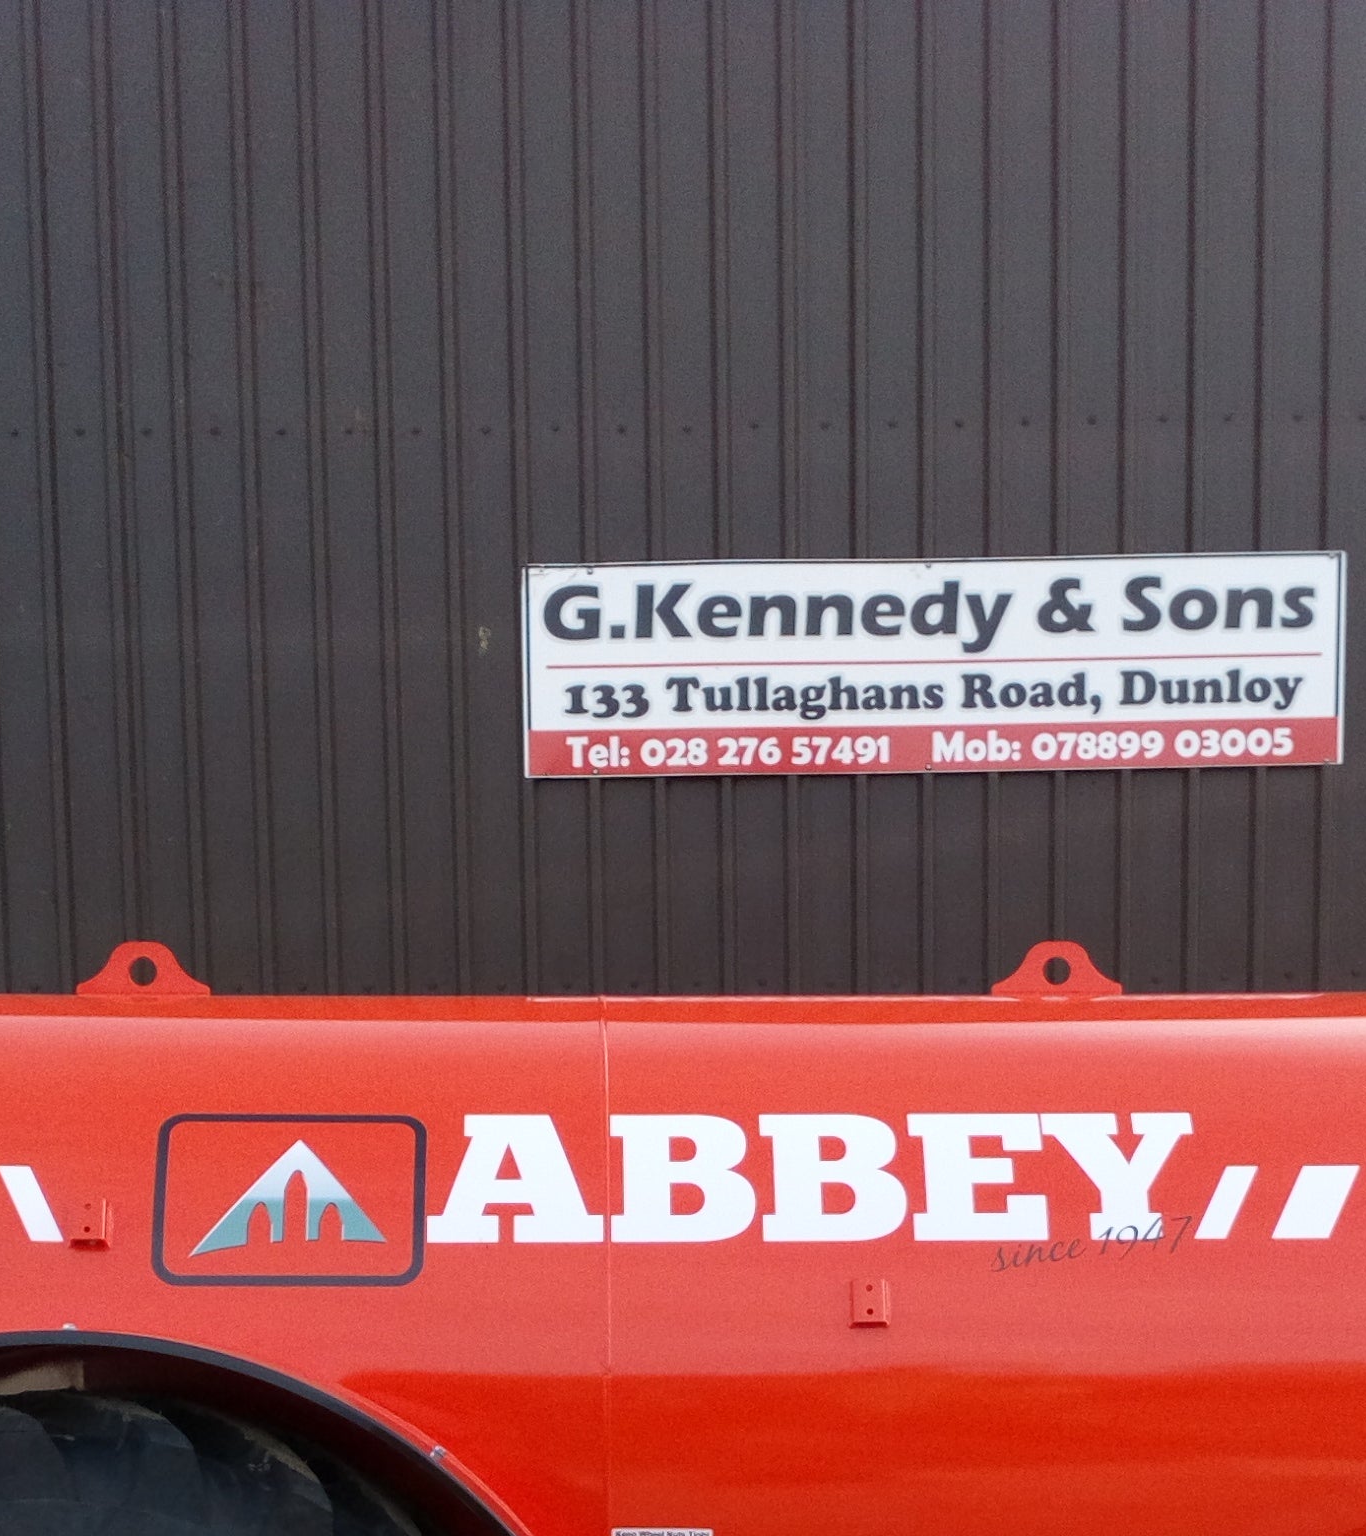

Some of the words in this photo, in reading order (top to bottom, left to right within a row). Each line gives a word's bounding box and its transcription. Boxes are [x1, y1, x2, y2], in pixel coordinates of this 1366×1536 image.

[543, 579, 1014, 654] G.Kennedy
[1037, 577, 1096, 633] &
[1122, 576, 1315, 632] Sons
[564, 684, 650, 718] 133
[666, 675, 945, 721] Tullaghans
[960, 671, 1102, 715] Road,
[1119, 669, 1303, 710] Dunloy
[565, 736, 631, 768] Tel:
[640, 736, 709, 767] 028
[717, 735, 782, 765] 276
[791, 734, 891, 764] 57491
[932, 730, 1022, 763] Mob:
[1031, 729, 1165, 761] 078899
[1174, 727, 1295, 758] 03005
[427, 1112, 1194, 1244] ABBEY
[990, 1237, 1086, 1273] since
[1098, 1215, 1193, 1261] 1947
